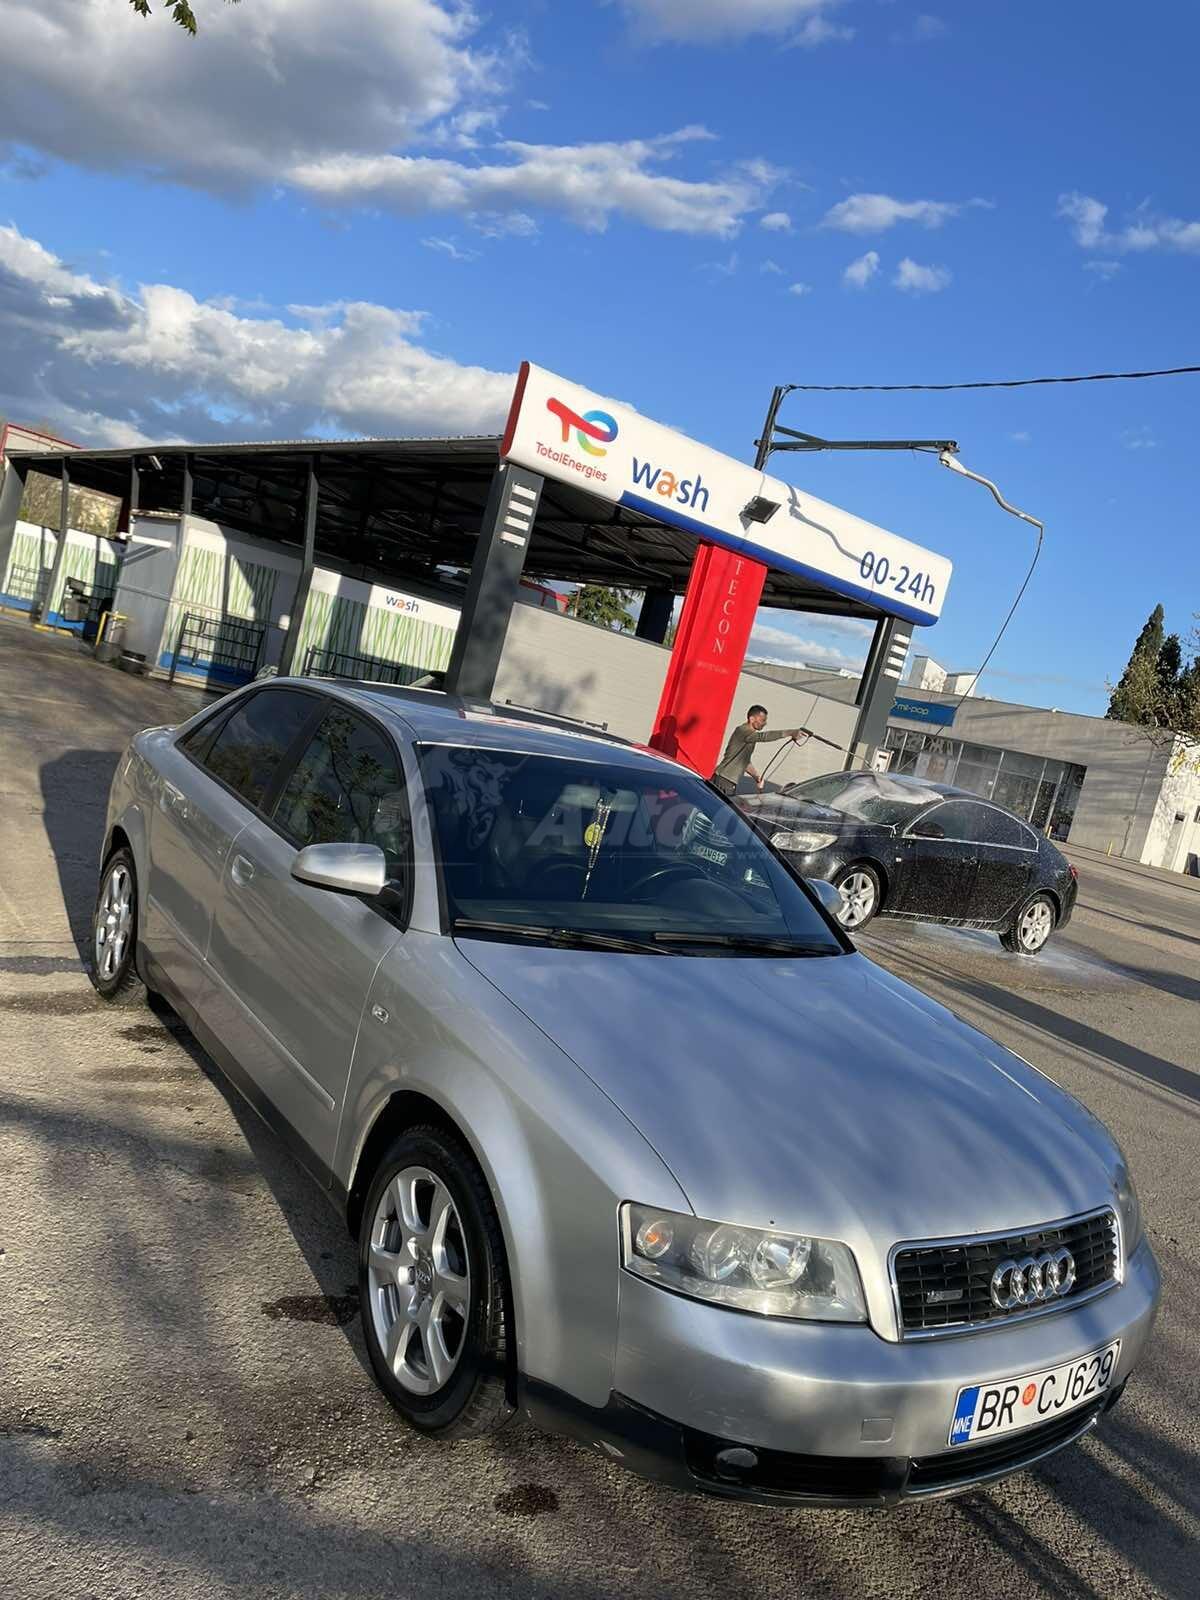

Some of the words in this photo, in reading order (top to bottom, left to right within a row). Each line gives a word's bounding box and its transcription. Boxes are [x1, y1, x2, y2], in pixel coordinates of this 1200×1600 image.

[536, 441, 608, 482] TotalEnergies
[632, 457, 710, 512] wash
[386, 595, 419, 613] wash
[860, 551, 935, 604] 00-24h
[712, 559, 744, 654] TECON
[977, 1385, 1019, 1431] BR
[1037, 1350, 1114, 1414] CJ629
[952, 1415, 973, 1434] MNE
